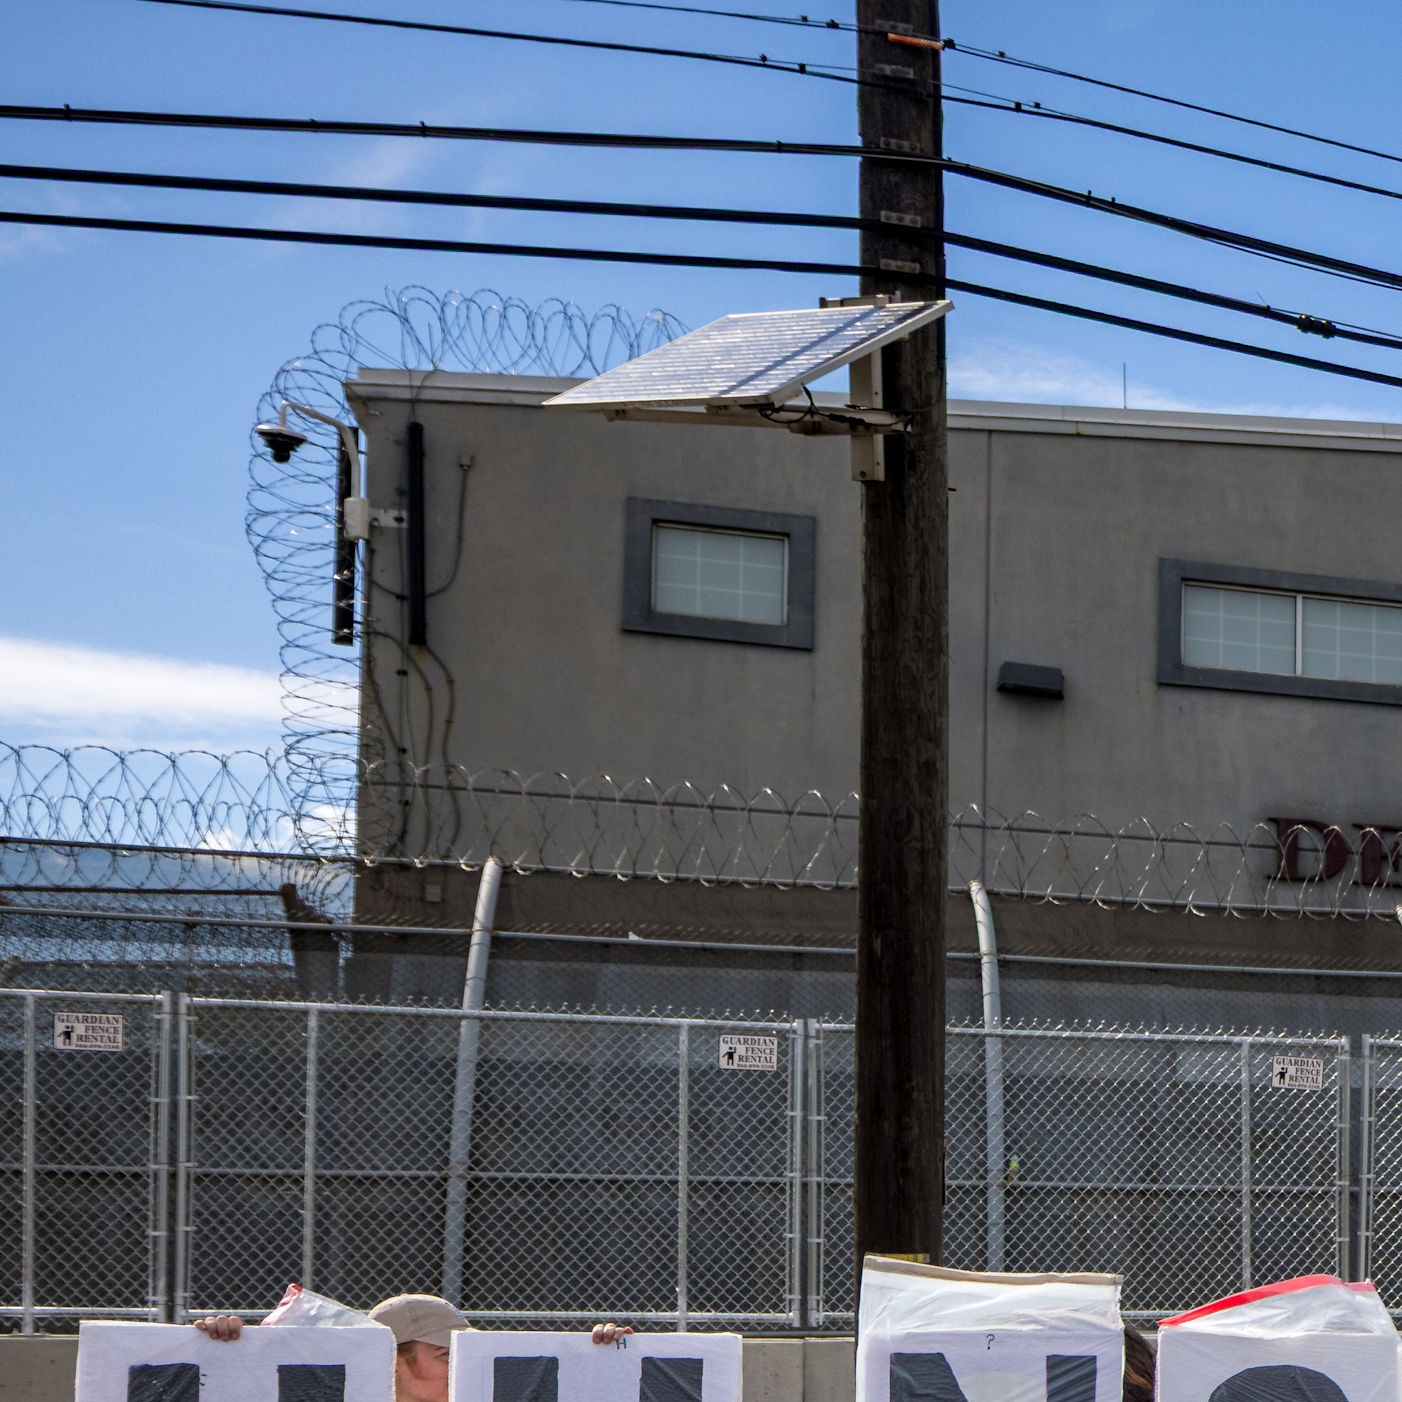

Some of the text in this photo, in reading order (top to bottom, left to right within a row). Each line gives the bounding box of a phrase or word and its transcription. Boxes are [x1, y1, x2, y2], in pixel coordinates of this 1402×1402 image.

[57, 1014, 119, 1024] GUARDIAN
[84, 1025, 120, 1034] FENCE
[76, 1034, 119, 1044] RENTAL
[722, 1037, 775, 1046] GUARDIAN
[745, 1046, 774, 1055] FENCE
[738, 1055, 774, 1064] RENTAL
[1276, 1057, 1320, 1068] GUARDIAN
[1295, 1068, 1320, 1076] FENCE
[1288, 1076, 1320, 1085] RENTAL
[616, 1337, 627, 1350] H
